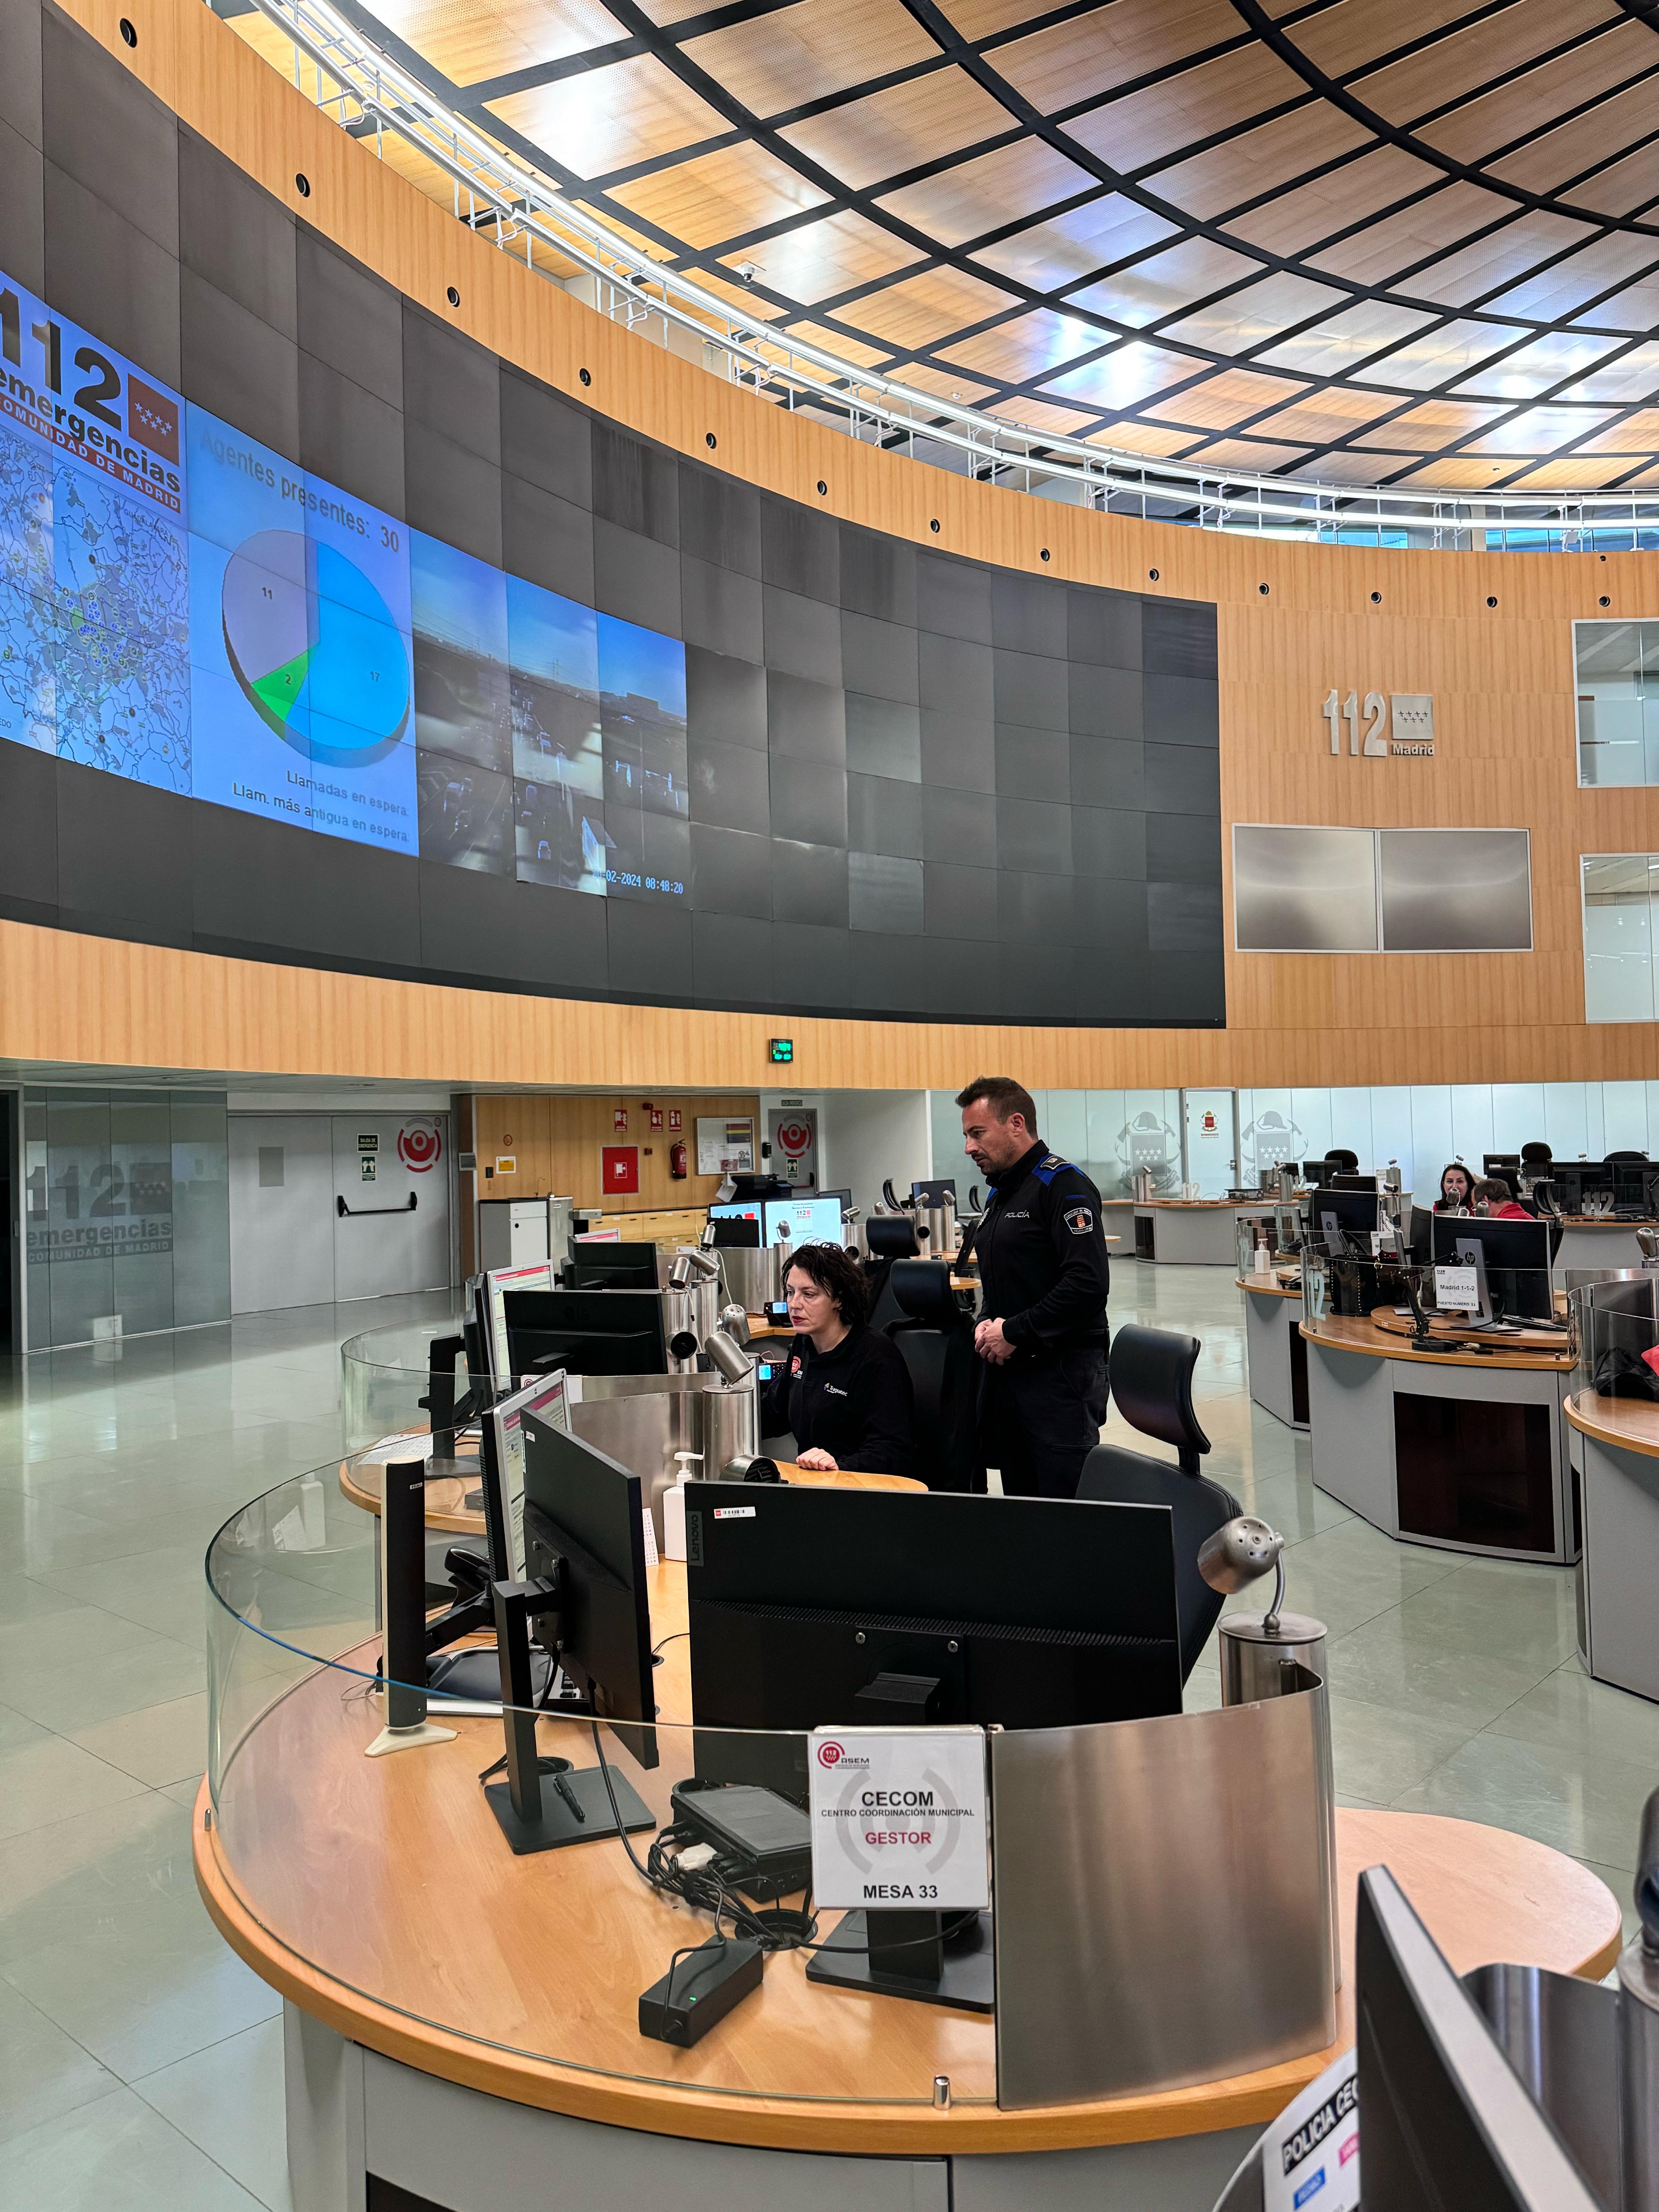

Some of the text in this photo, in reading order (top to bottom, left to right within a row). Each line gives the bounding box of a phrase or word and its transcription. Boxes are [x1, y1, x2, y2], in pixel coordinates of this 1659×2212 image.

[0, 288, 121, 432] 112
[0, 397, 178, 509] OMUNIDAD DE MADRID
[200, 427, 399, 553] Agentes presentes: 30
[262, 587, 273, 600] 11
[285, 674, 291, 685] 2
[369, 670, 381, 682] 17
[1323, 689, 1387, 756] 112
[1392, 743, 1435, 756] Madrid
[287, 770, 348, 799] Llamadas
[352, 792, 366, 804] en
[233, 782, 269, 804] Llam.
[273, 798, 300, 813] más
[304, 807, 348, 826] antigua
[353, 820, 366, 831] en
[645, 877, 683, 894] 08:48:20
[27, 1164, 126, 1221] 112
[1583, 1192, 1615, 1216] 112
[27, 1218, 172, 1246] emergencias
[28, 1247, 100, 1262] COMUNIDAD
[126, 1241, 169, 1252] MADRID
[830, 1386, 848, 1396] Tragsatec
[691, 1514, 699, 1561] Lenovo
[861, 1791, 934, 1806] CECOM
[859, 1808, 926, 1817] COORDINACIÓN
[865, 1832, 932, 1845] GESTOR
[864, 1885, 938, 1898] MESA 33
[1283, 2104, 1337, 2173] POLICIA
